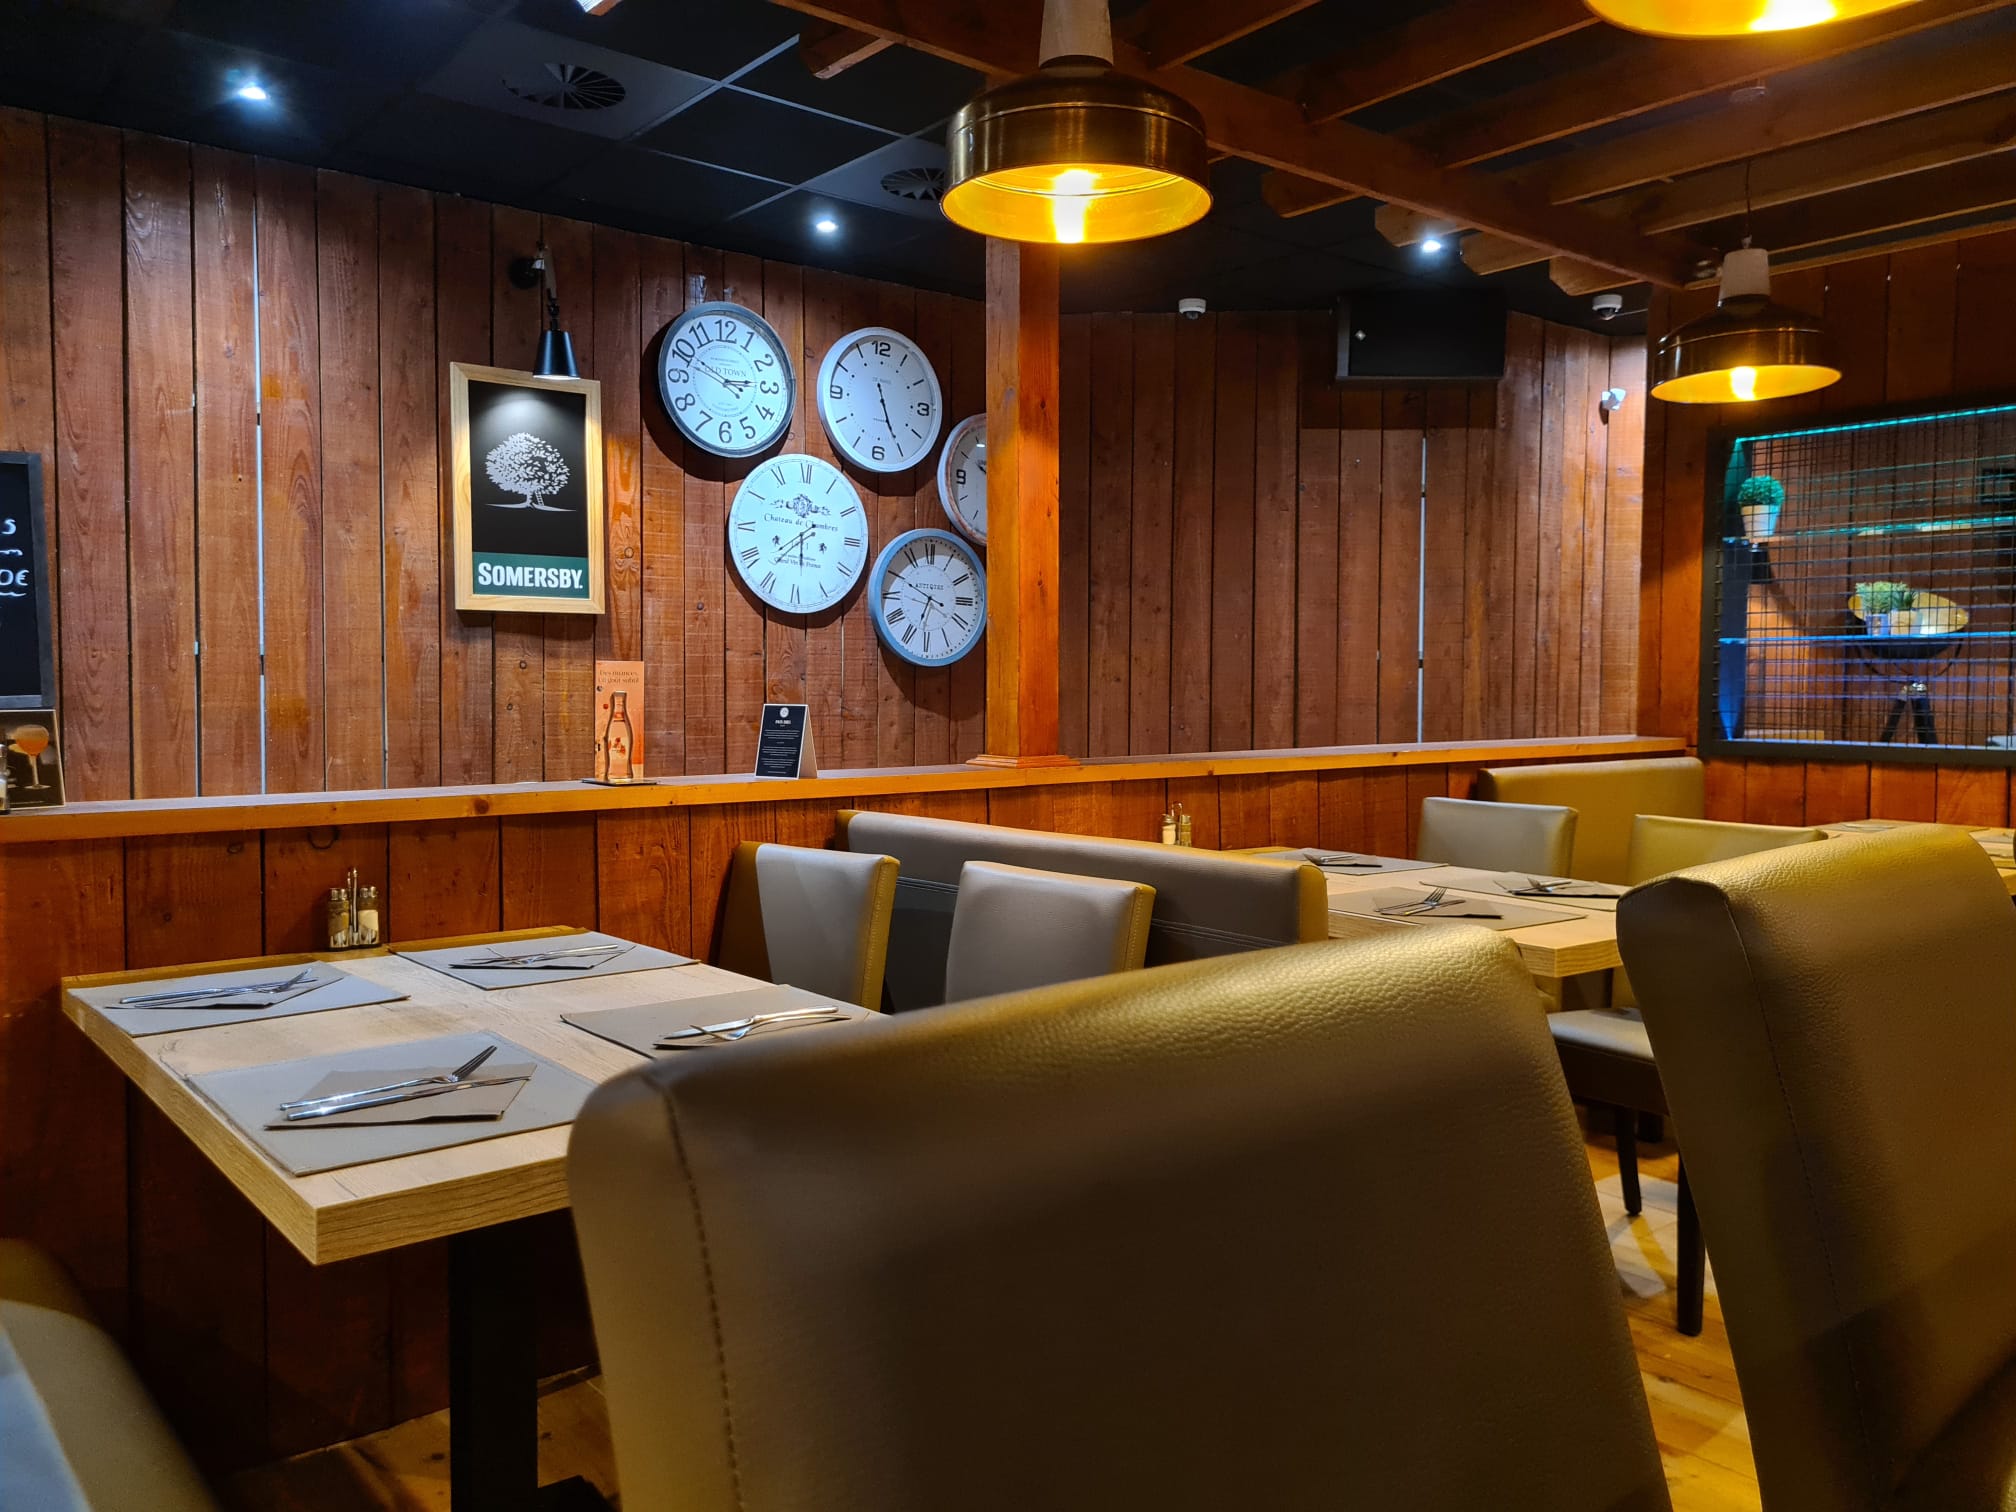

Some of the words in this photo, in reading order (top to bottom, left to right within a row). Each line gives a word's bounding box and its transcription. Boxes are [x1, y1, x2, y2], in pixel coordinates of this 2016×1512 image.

[688, 321, 714, 349] 11
[714, 319, 737, 344] 12
[740, 331, 755, 352] 1
[871, 340, 892, 358] 12
[672, 338, 696, 368] 10
[753, 353, 774, 372] 2
[668, 368, 689, 384] 9
[759, 380, 779, 395] 3
[830, 385, 843, 400] 9
[675, 393, 695, 411] 8
[917, 402, 930, 417] 3
[695, 410, 713, 432] 7
[755, 404, 775, 421] 4
[718, 421, 733, 444] 6
[739, 416, 756, 440] 5
[872, 446, 885, 461] 6
[956, 469, 966, 485] 9
